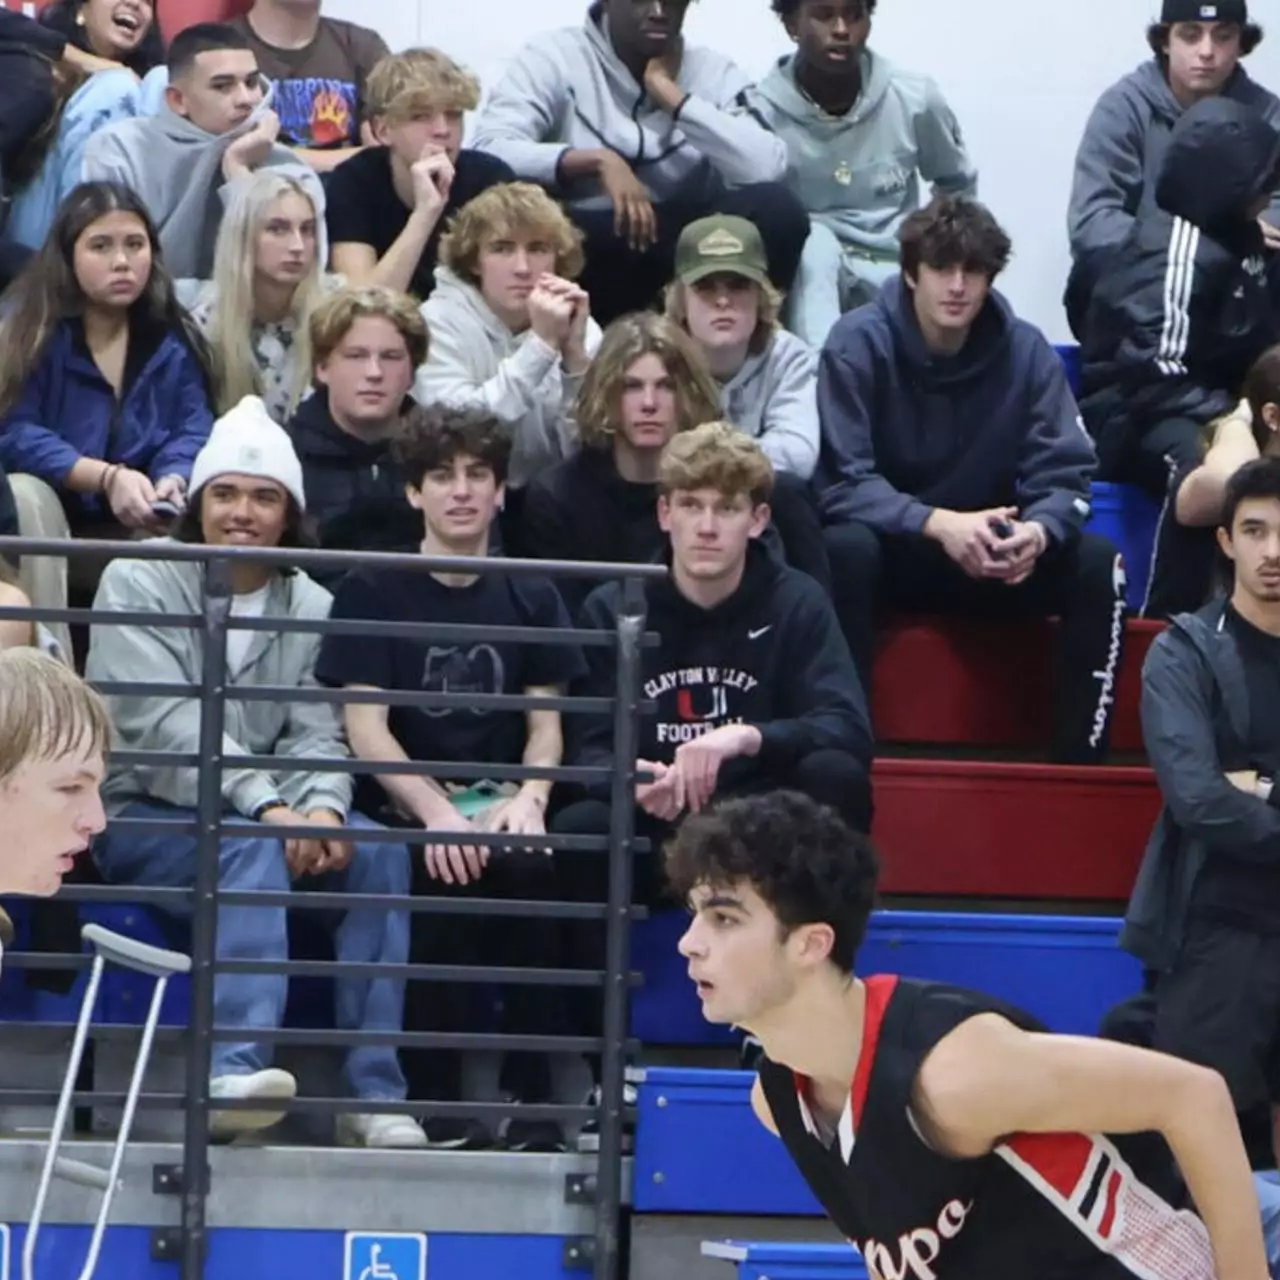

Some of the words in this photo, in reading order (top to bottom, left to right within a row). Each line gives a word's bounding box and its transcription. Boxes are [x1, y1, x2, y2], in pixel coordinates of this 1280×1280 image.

[643, 666, 704, 699] CLAYTON
[705, 666, 758, 692] VLLEY
[656, 716, 744, 743] FOOTB
